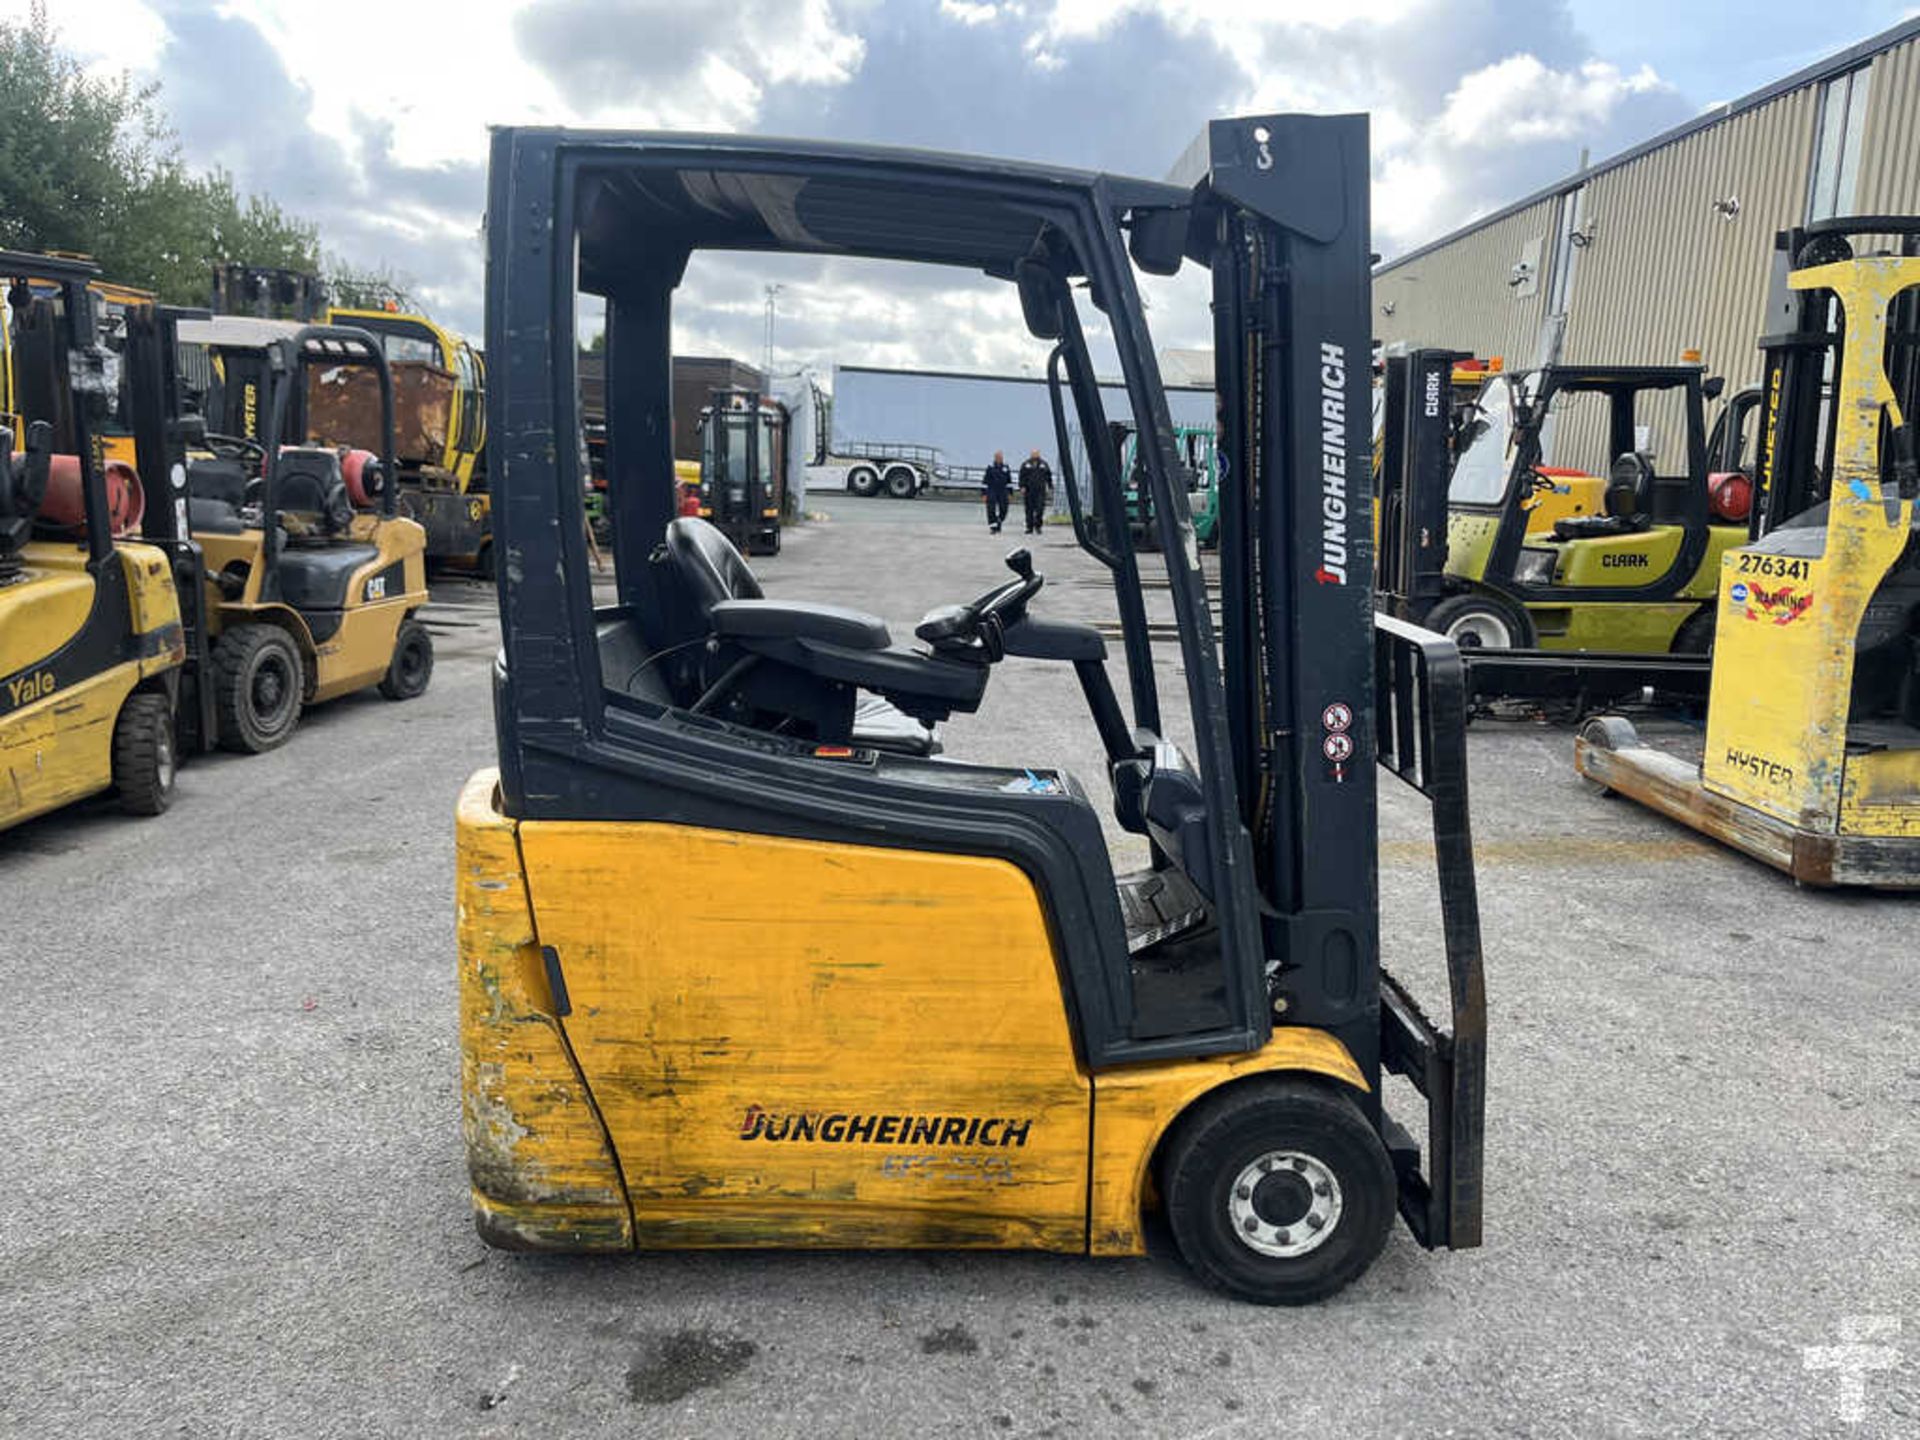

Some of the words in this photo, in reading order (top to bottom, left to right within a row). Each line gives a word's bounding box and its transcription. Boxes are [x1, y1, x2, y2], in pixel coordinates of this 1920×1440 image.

[1425, 372, 1440, 417] CLARK
[1315, 342, 1347, 585] JUNGHEINRICH
[1602, 554, 1649, 568] CLARK
[1740, 554, 1809, 580] 276341
[367, 576, 385, 599] CAT
[8, 671, 56, 707] Yale
[1726, 748, 1793, 790] HYSTER
[740, 1104, 1032, 1147] JUNGHEINRICH
